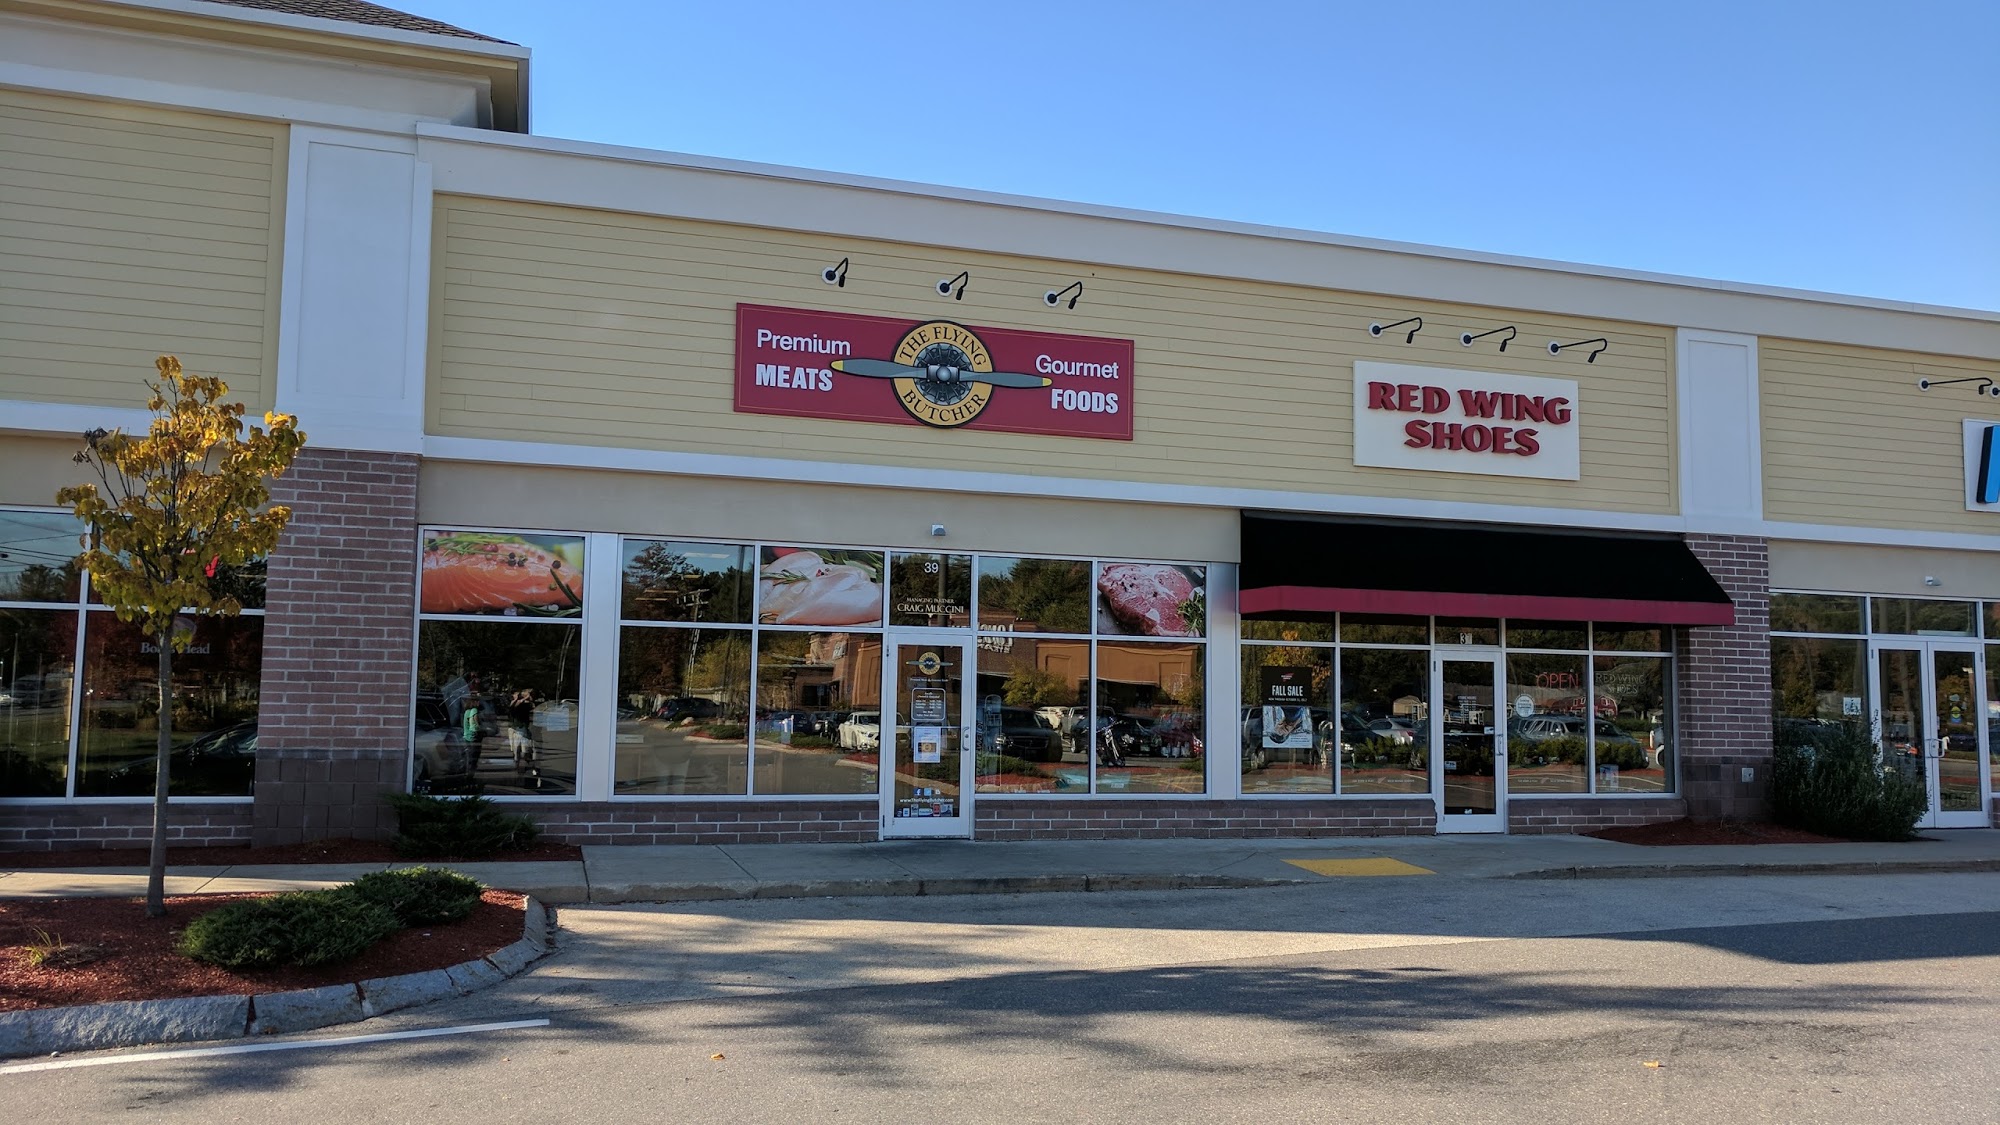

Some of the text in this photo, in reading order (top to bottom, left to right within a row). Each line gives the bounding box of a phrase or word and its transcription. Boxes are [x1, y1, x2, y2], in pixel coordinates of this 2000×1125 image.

[757, 328, 851, 356] Premium
[900, 326, 987, 366] THE FLYING
[755, 363, 833, 392] MEATS
[1035, 354, 1119, 379] Gourmet
[902, 389, 986, 422] BUTCHER
[1051, 388, 1119, 414] FOODS
[1367, 381, 1571, 425] RED WING
[1403, 419, 1540, 457] SHOES
[924, 562, 939, 574] 39
[896, 603, 964, 614] CRAIG MUCCINI
[1271, 685, 1304, 697] FALL SALE
[1536, 672, 1579, 690] OPEN
